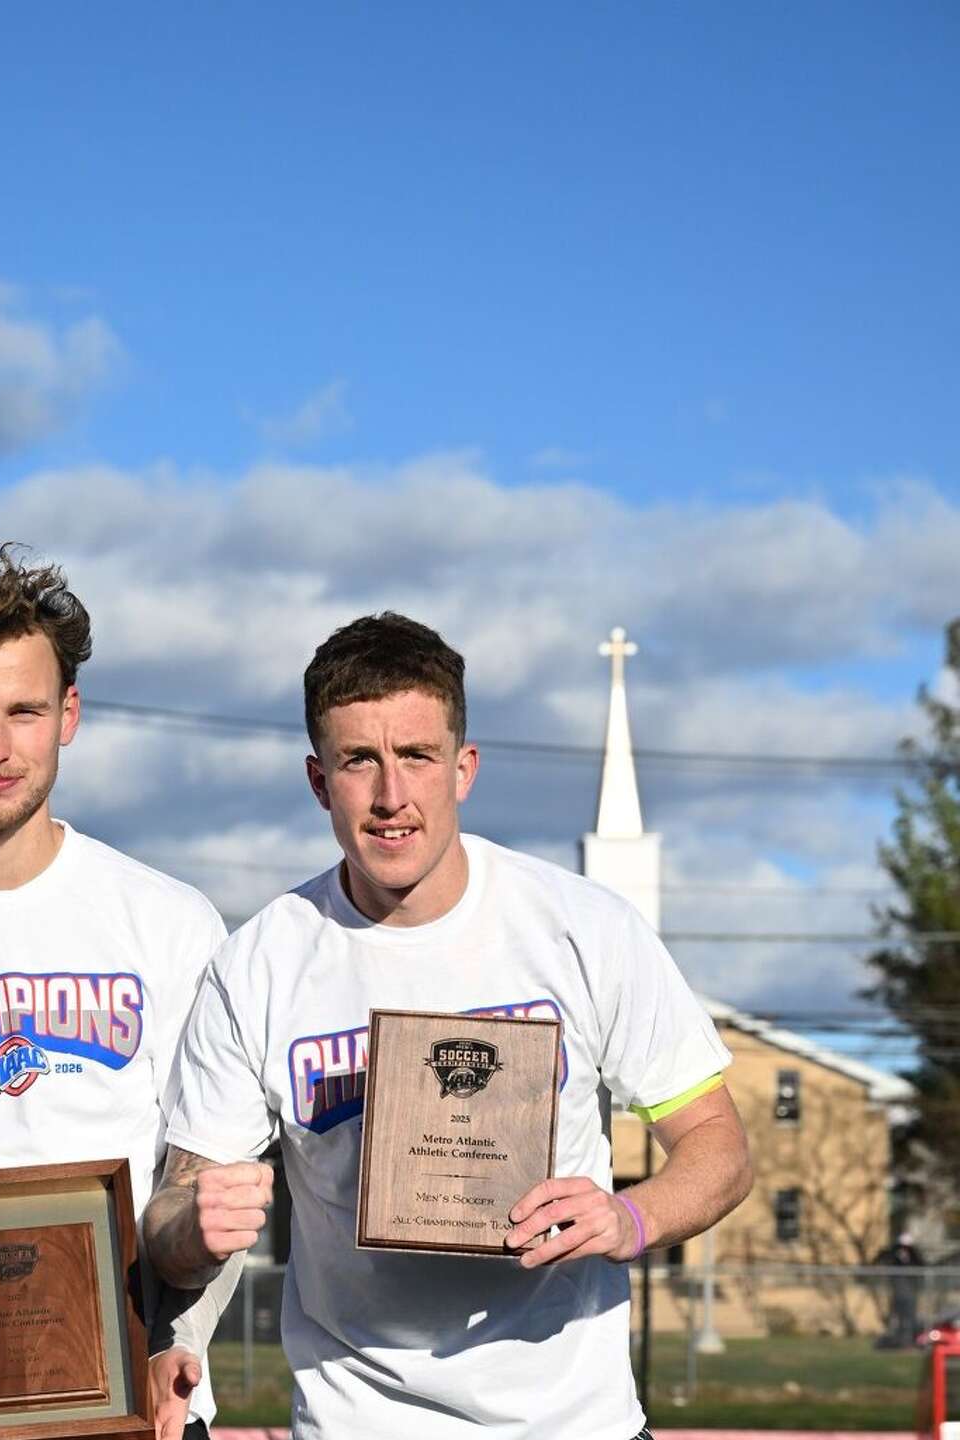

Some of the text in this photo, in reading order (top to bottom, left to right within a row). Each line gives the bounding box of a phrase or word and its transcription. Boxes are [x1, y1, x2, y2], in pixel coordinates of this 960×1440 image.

[440, 1049, 489, 1063] SOCCER
[55, 1062, 83, 1074] 2026
[450, 1114, 471, 1123] 2025
[422, 1134, 497, 1148] Metro Atlantic
[408, 1146, 508, 1161] Athletic Conference
